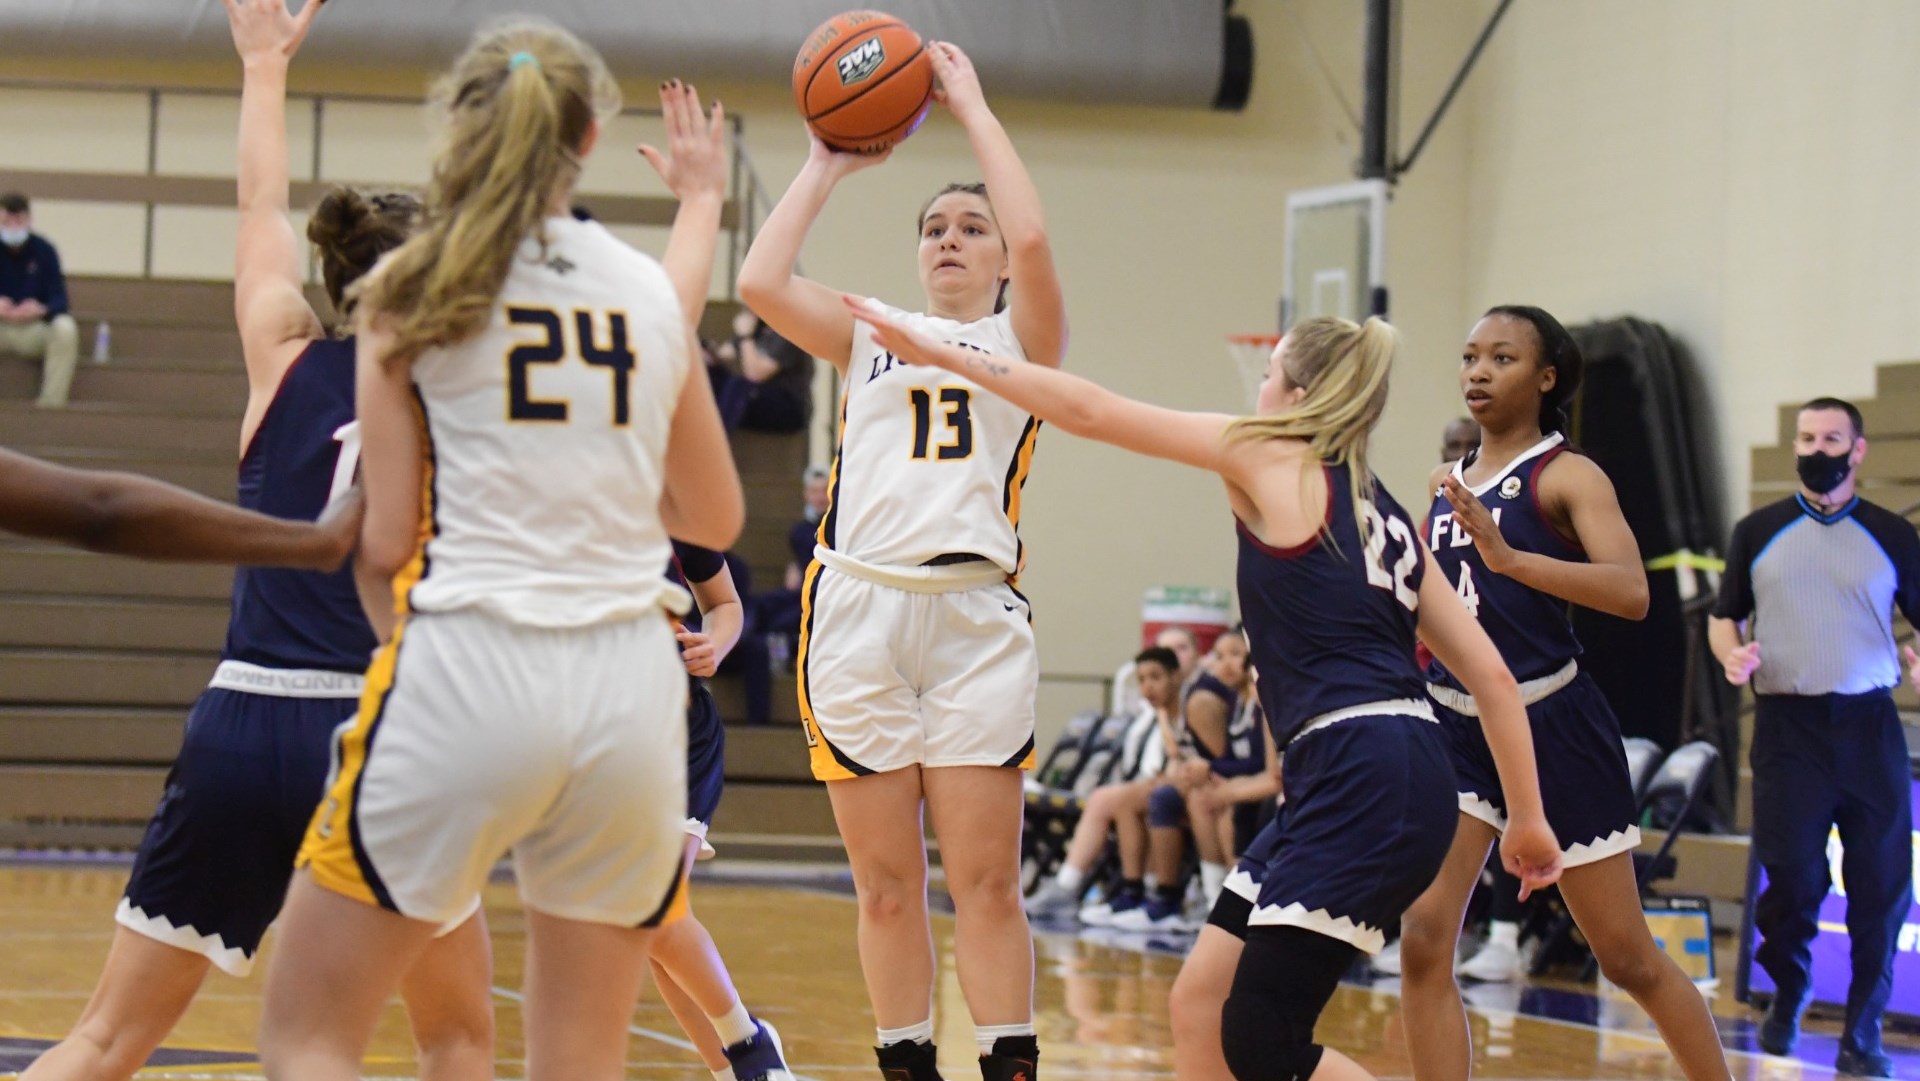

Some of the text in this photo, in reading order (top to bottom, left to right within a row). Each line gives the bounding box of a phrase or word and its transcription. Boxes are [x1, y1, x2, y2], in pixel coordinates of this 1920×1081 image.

[838, 38, 881, 76] MAC
[505, 304, 636, 428] 24
[908, 385, 976, 463] 13
[1358, 499, 1419, 612] 22
[1457, 560, 1479, 618] 4
